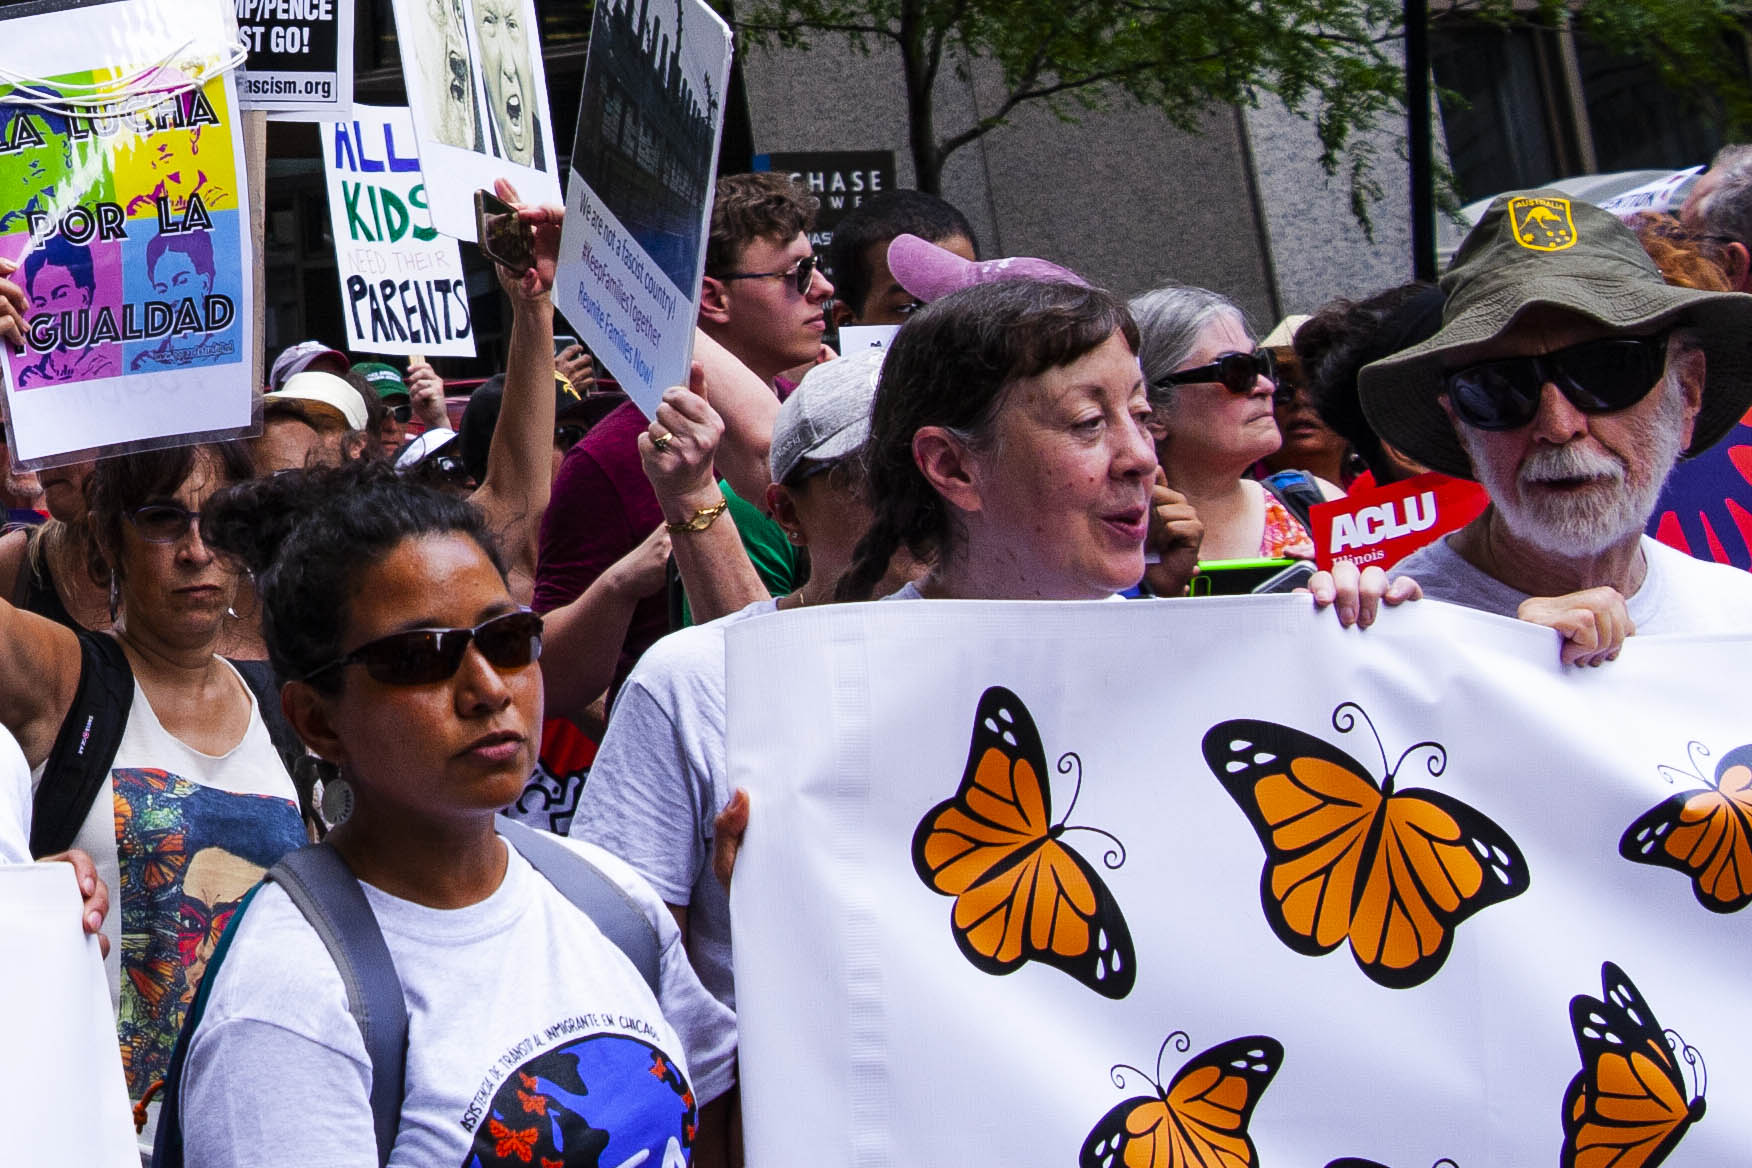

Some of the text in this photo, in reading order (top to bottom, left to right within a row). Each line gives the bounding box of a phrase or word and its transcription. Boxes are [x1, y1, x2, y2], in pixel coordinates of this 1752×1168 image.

[239, 25, 311, 54] ST GO!
[62, 87, 222, 143] LUCHA
[335, 120, 421, 173] ALL
[26, 192, 215, 250] POR LA
[341, 179, 439, 243] KIDS
[1514, 198, 1564, 211] AUSTRALIA
[347, 248, 451, 274] NEED THEIR
[578, 190, 592, 222] We
[590, 208, 605, 237] are
[603, 223, 616, 253] not
[621, 238, 645, 280] fascist
[645, 270, 677, 321] country!
[14, 293, 236, 357] GUALDAD
[346, 274, 471, 345] PARENTS
[577, 281, 656, 389] Reunite Families Now!
[1330, 490, 1438, 554] ACLU
[459, 1075, 496, 1134] ASISTENCIA
[543, 1012, 599, 1042] INMIGRANTE
[602, 1013, 615, 1027] EN
